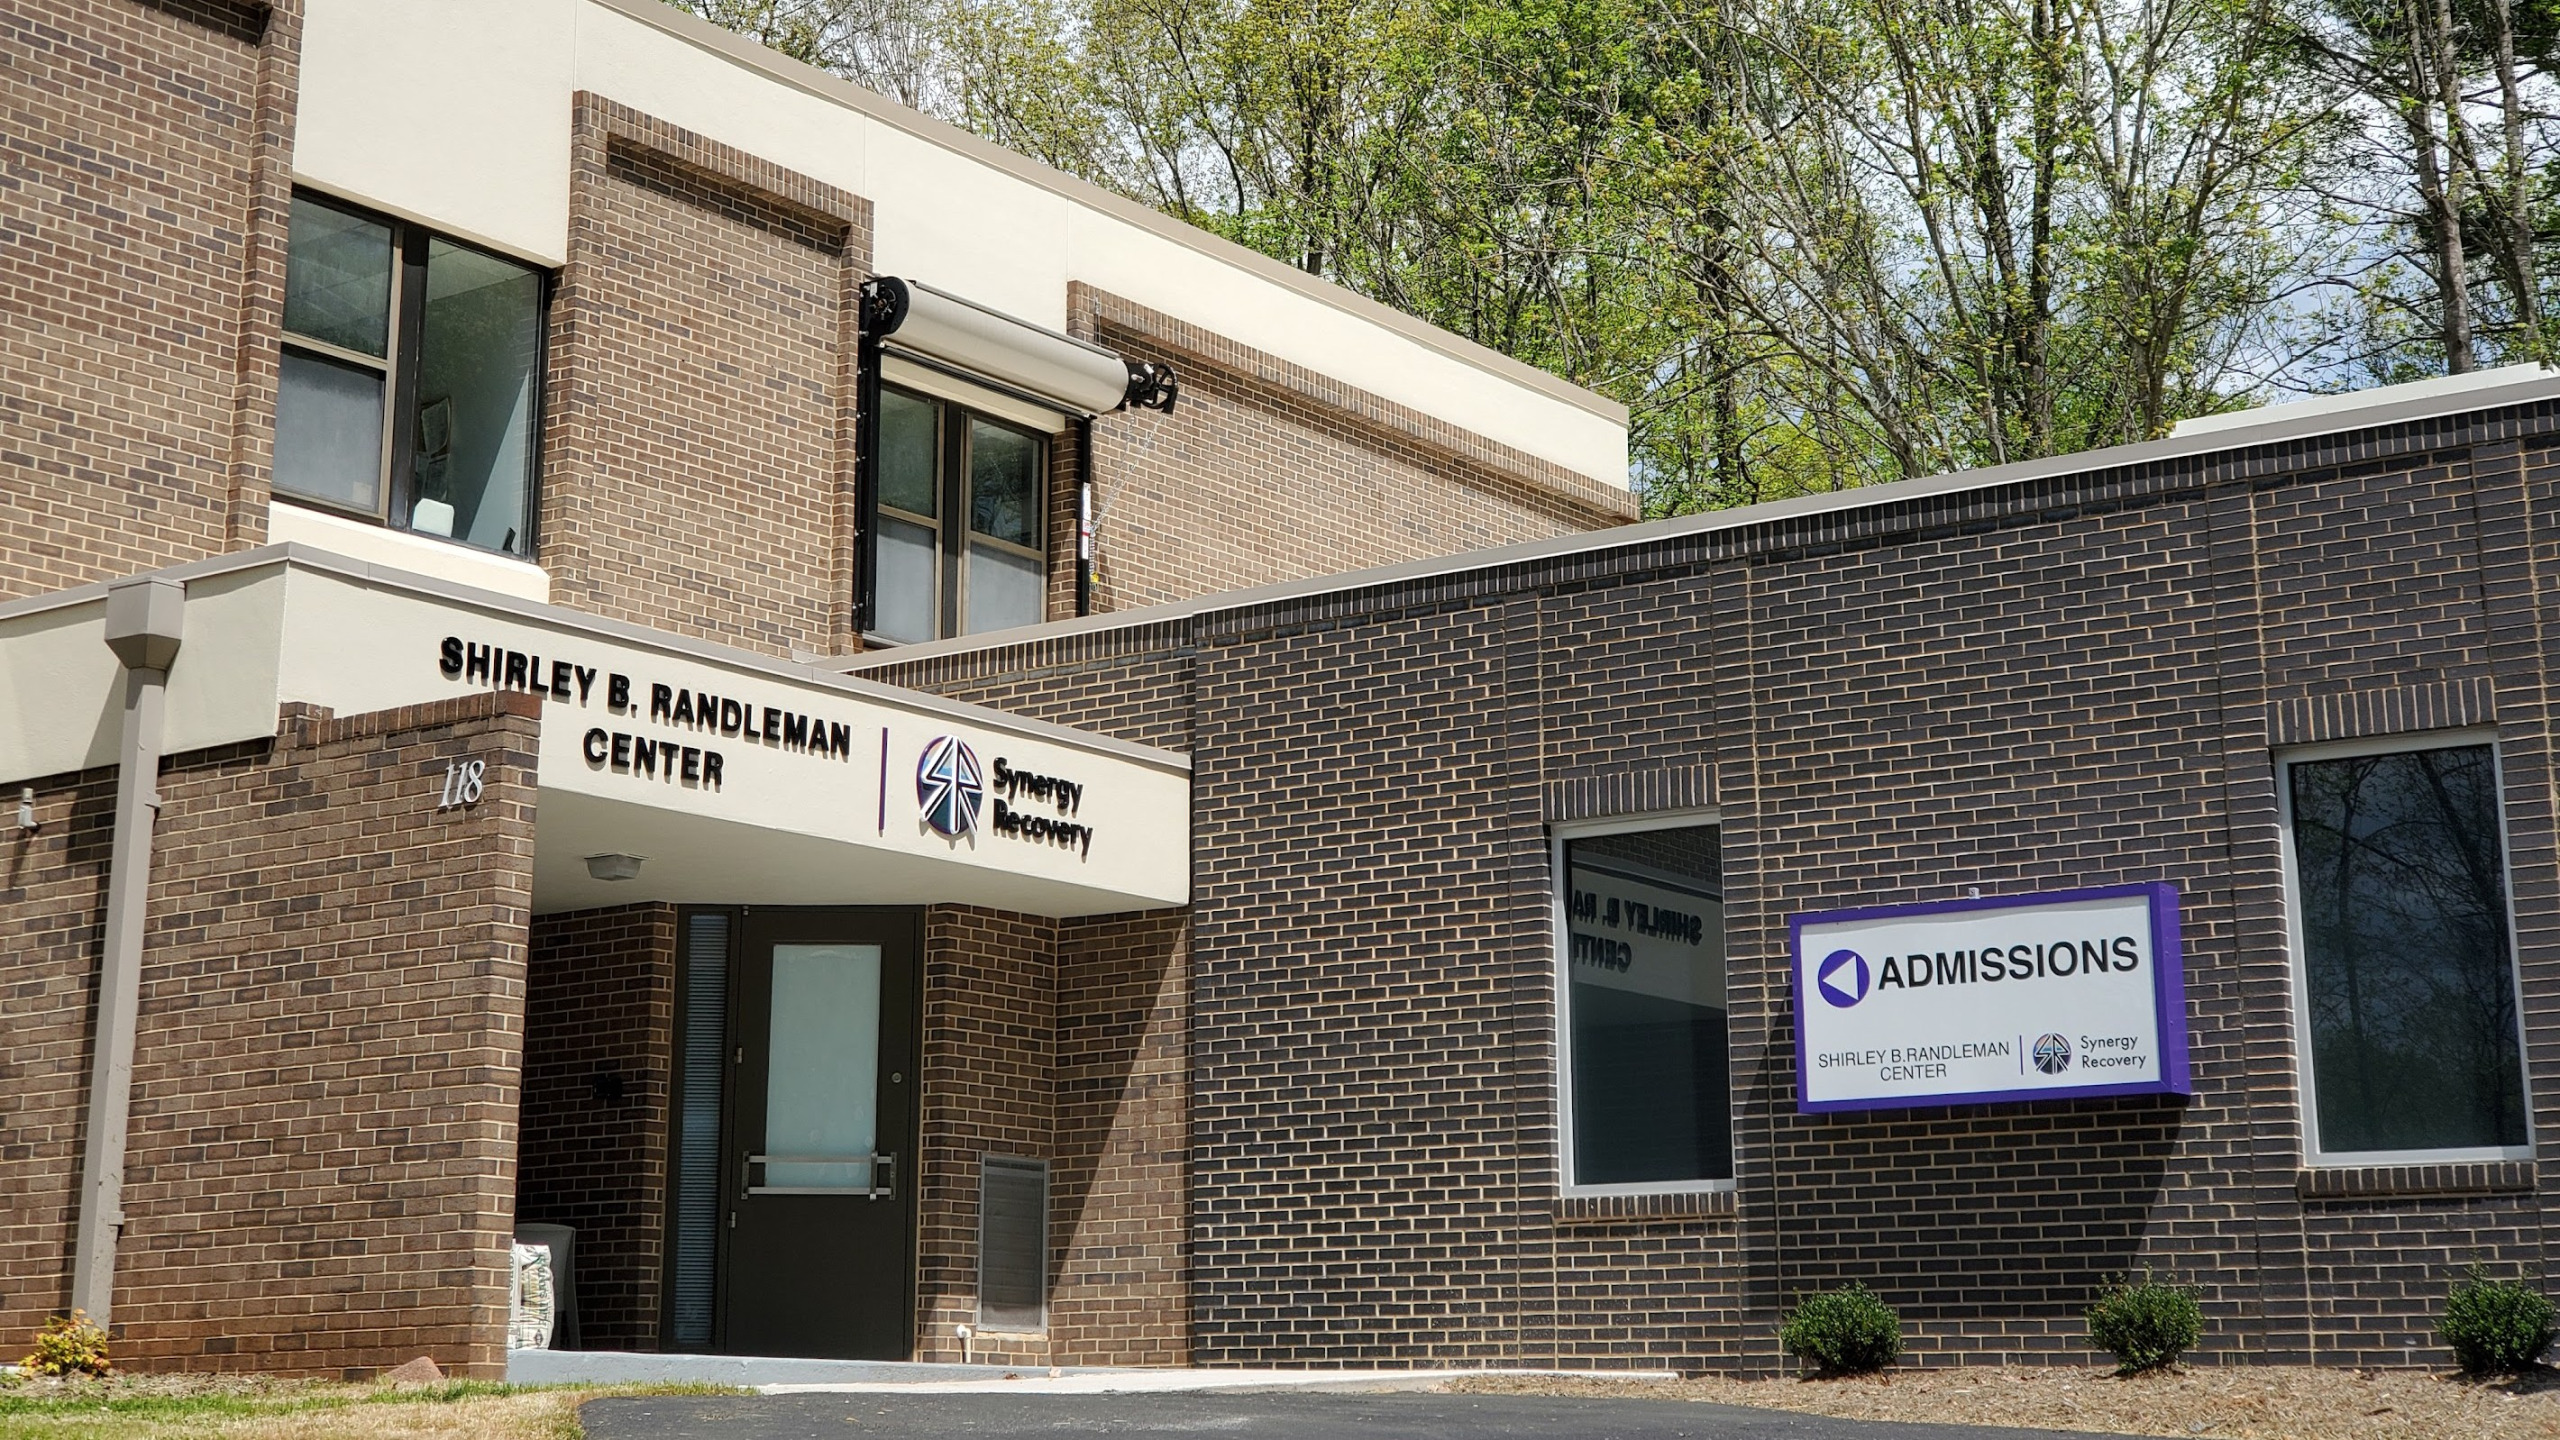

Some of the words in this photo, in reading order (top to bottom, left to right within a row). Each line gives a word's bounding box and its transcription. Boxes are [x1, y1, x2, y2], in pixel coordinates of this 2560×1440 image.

[440, 637, 596, 700] SHIRLEY
[608, 673, 637, 711] B.
[651, 683, 851, 756] RANDLEMAN
[583, 728, 724, 786] CENTER
[438, 760, 485, 807] 118
[993, 757, 1083, 813] Synergy
[993, 799, 1093, 856] Recovery
[1878, 936, 2139, 990] ADMISSIONS
[1818, 1050, 1887, 1068] SHIRLEY
[2081, 1035, 2138, 1053] Synergy
[2082, 1054, 2146, 1069] Recovery
[1880, 1063, 1947, 1081] CENTER
